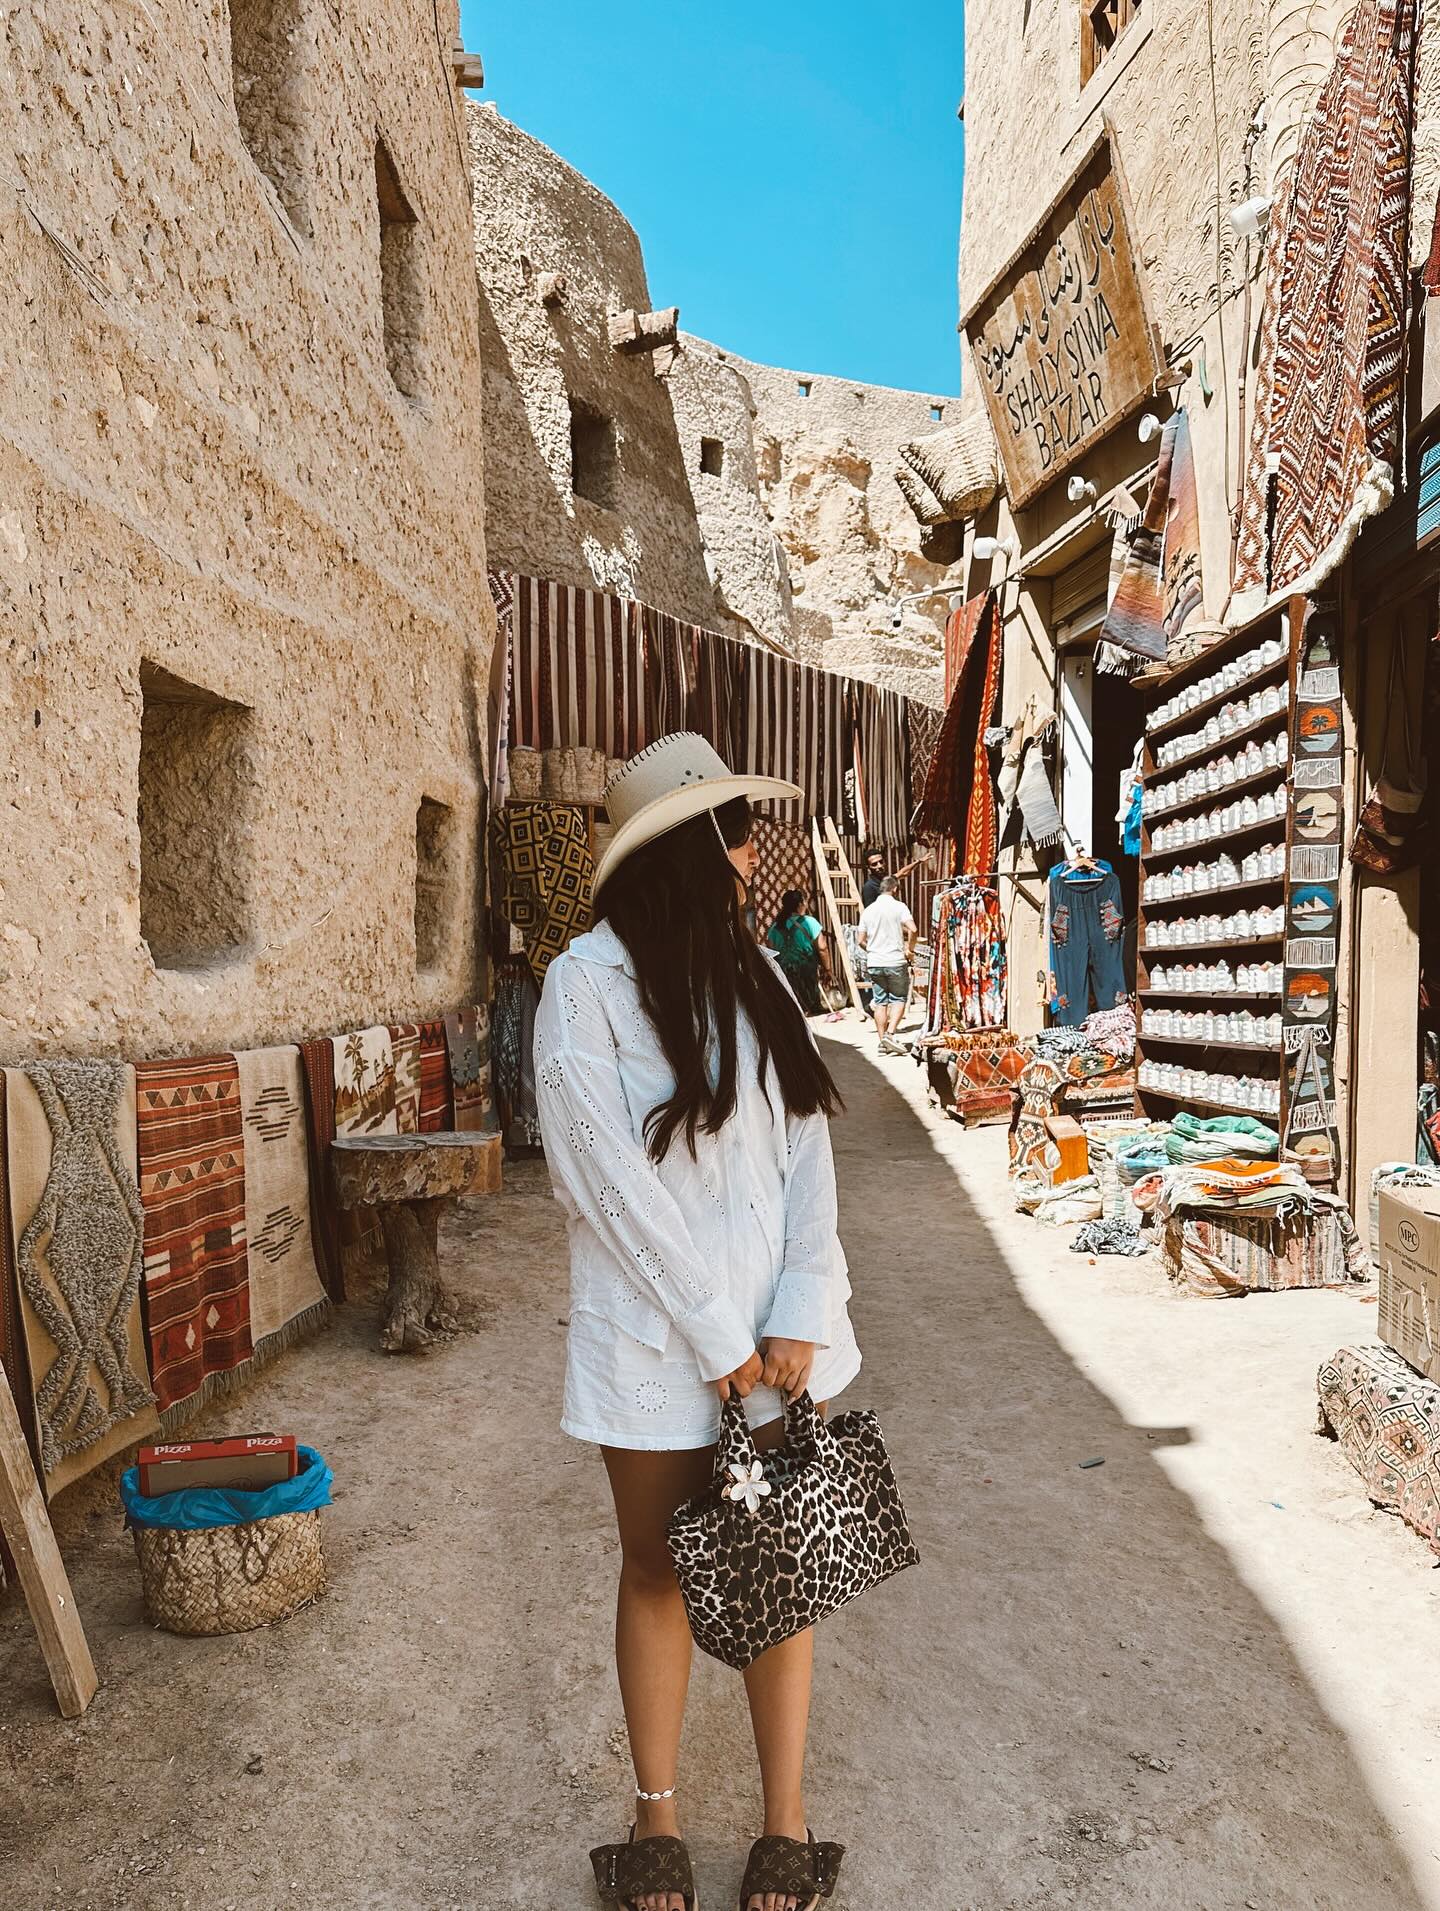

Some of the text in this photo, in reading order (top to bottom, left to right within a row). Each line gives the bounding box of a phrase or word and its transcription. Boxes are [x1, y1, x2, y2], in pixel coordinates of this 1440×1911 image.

[1006, 292, 1120, 435] SHALY SIWA
[1033, 371, 1108, 470] BAZAR
[1400, 1226, 1418, 1246] MPC
